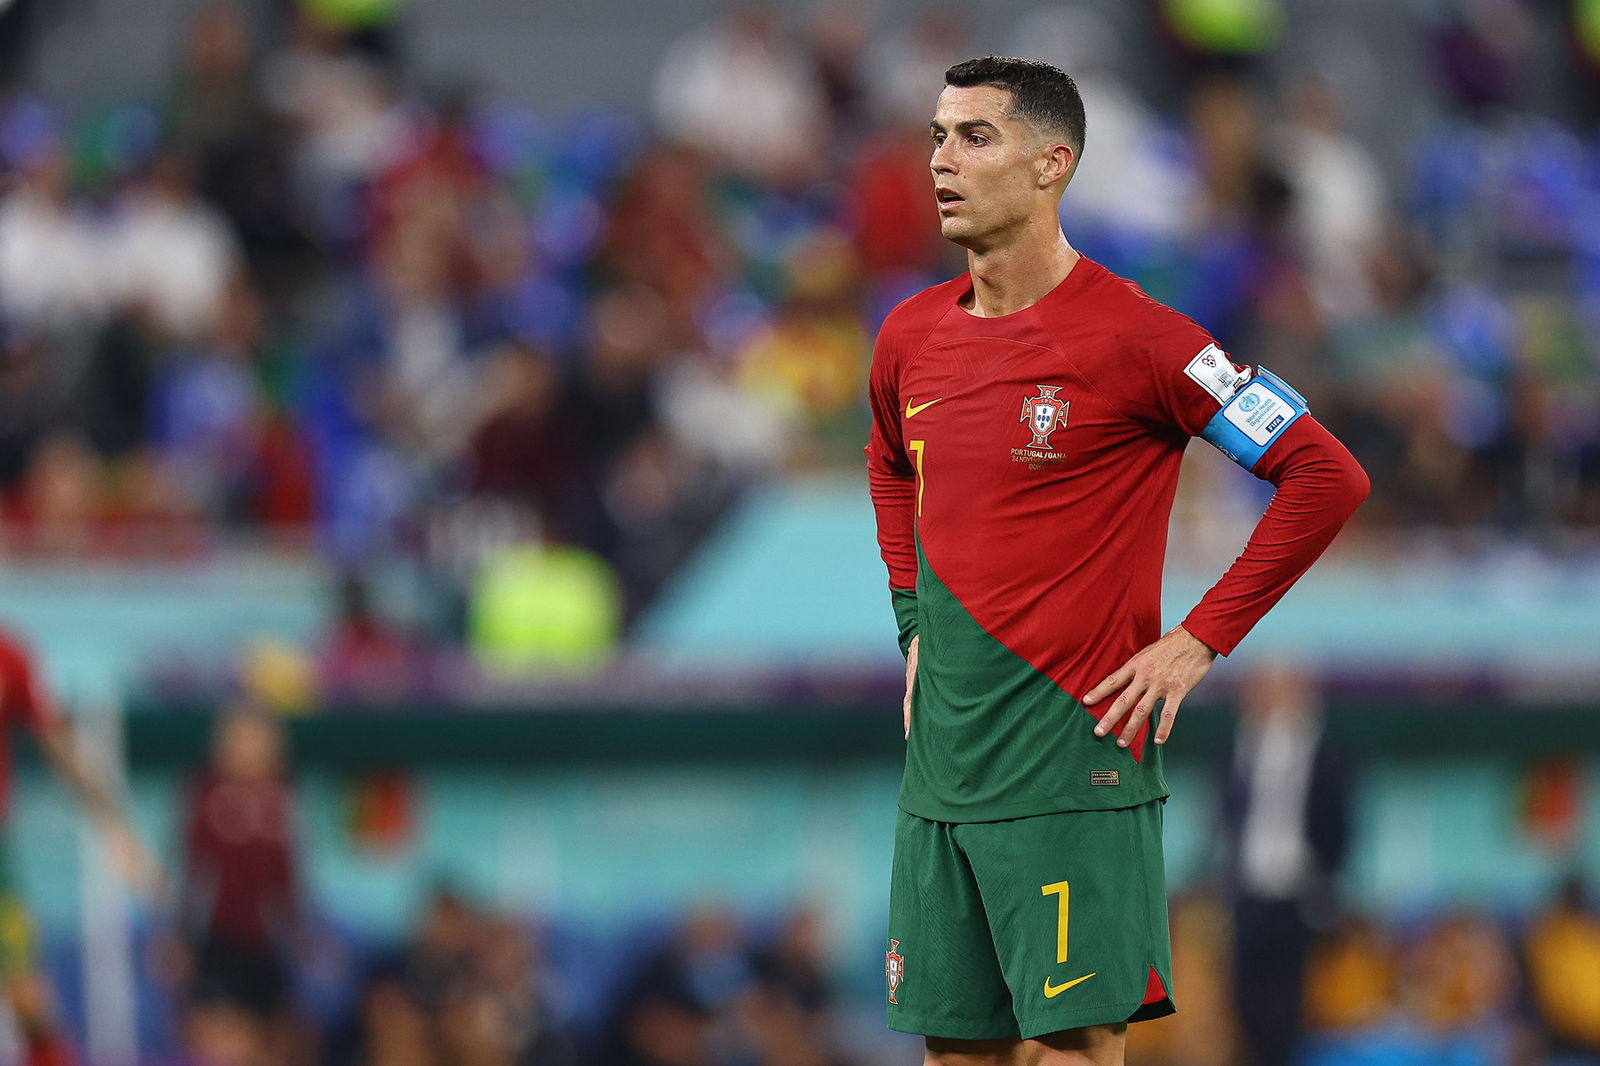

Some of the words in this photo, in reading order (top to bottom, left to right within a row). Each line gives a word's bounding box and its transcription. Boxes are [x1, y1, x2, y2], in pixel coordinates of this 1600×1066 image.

[1246, 410, 1259, 423] World
[1267, 417, 1282, 431] FIFA
[909, 440, 924, 517] 7
[1041, 881, 1069, 964] 7
